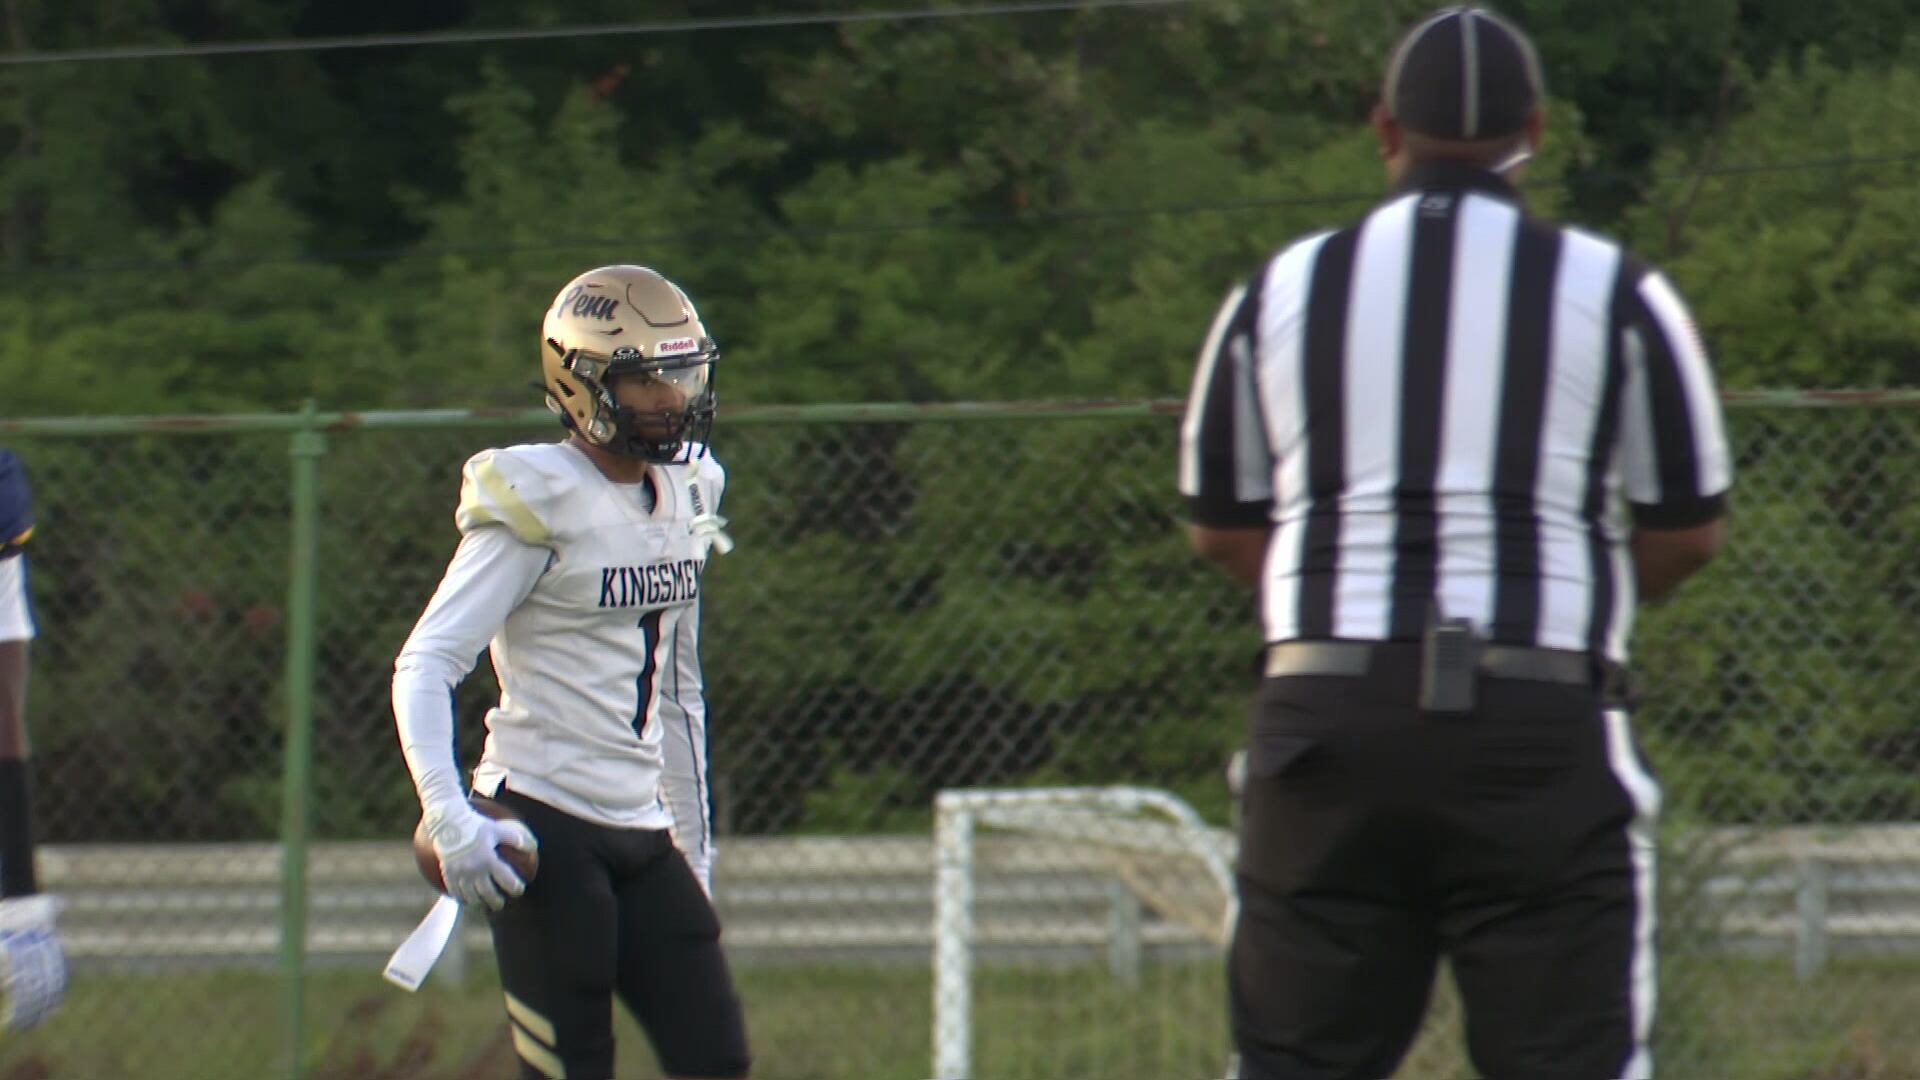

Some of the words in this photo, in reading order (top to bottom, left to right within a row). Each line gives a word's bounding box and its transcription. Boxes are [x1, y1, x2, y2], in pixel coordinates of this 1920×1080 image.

[557, 284, 619, 321] Penn
[660, 338, 696, 352] Riddell
[632, 608, 664, 740] 1
